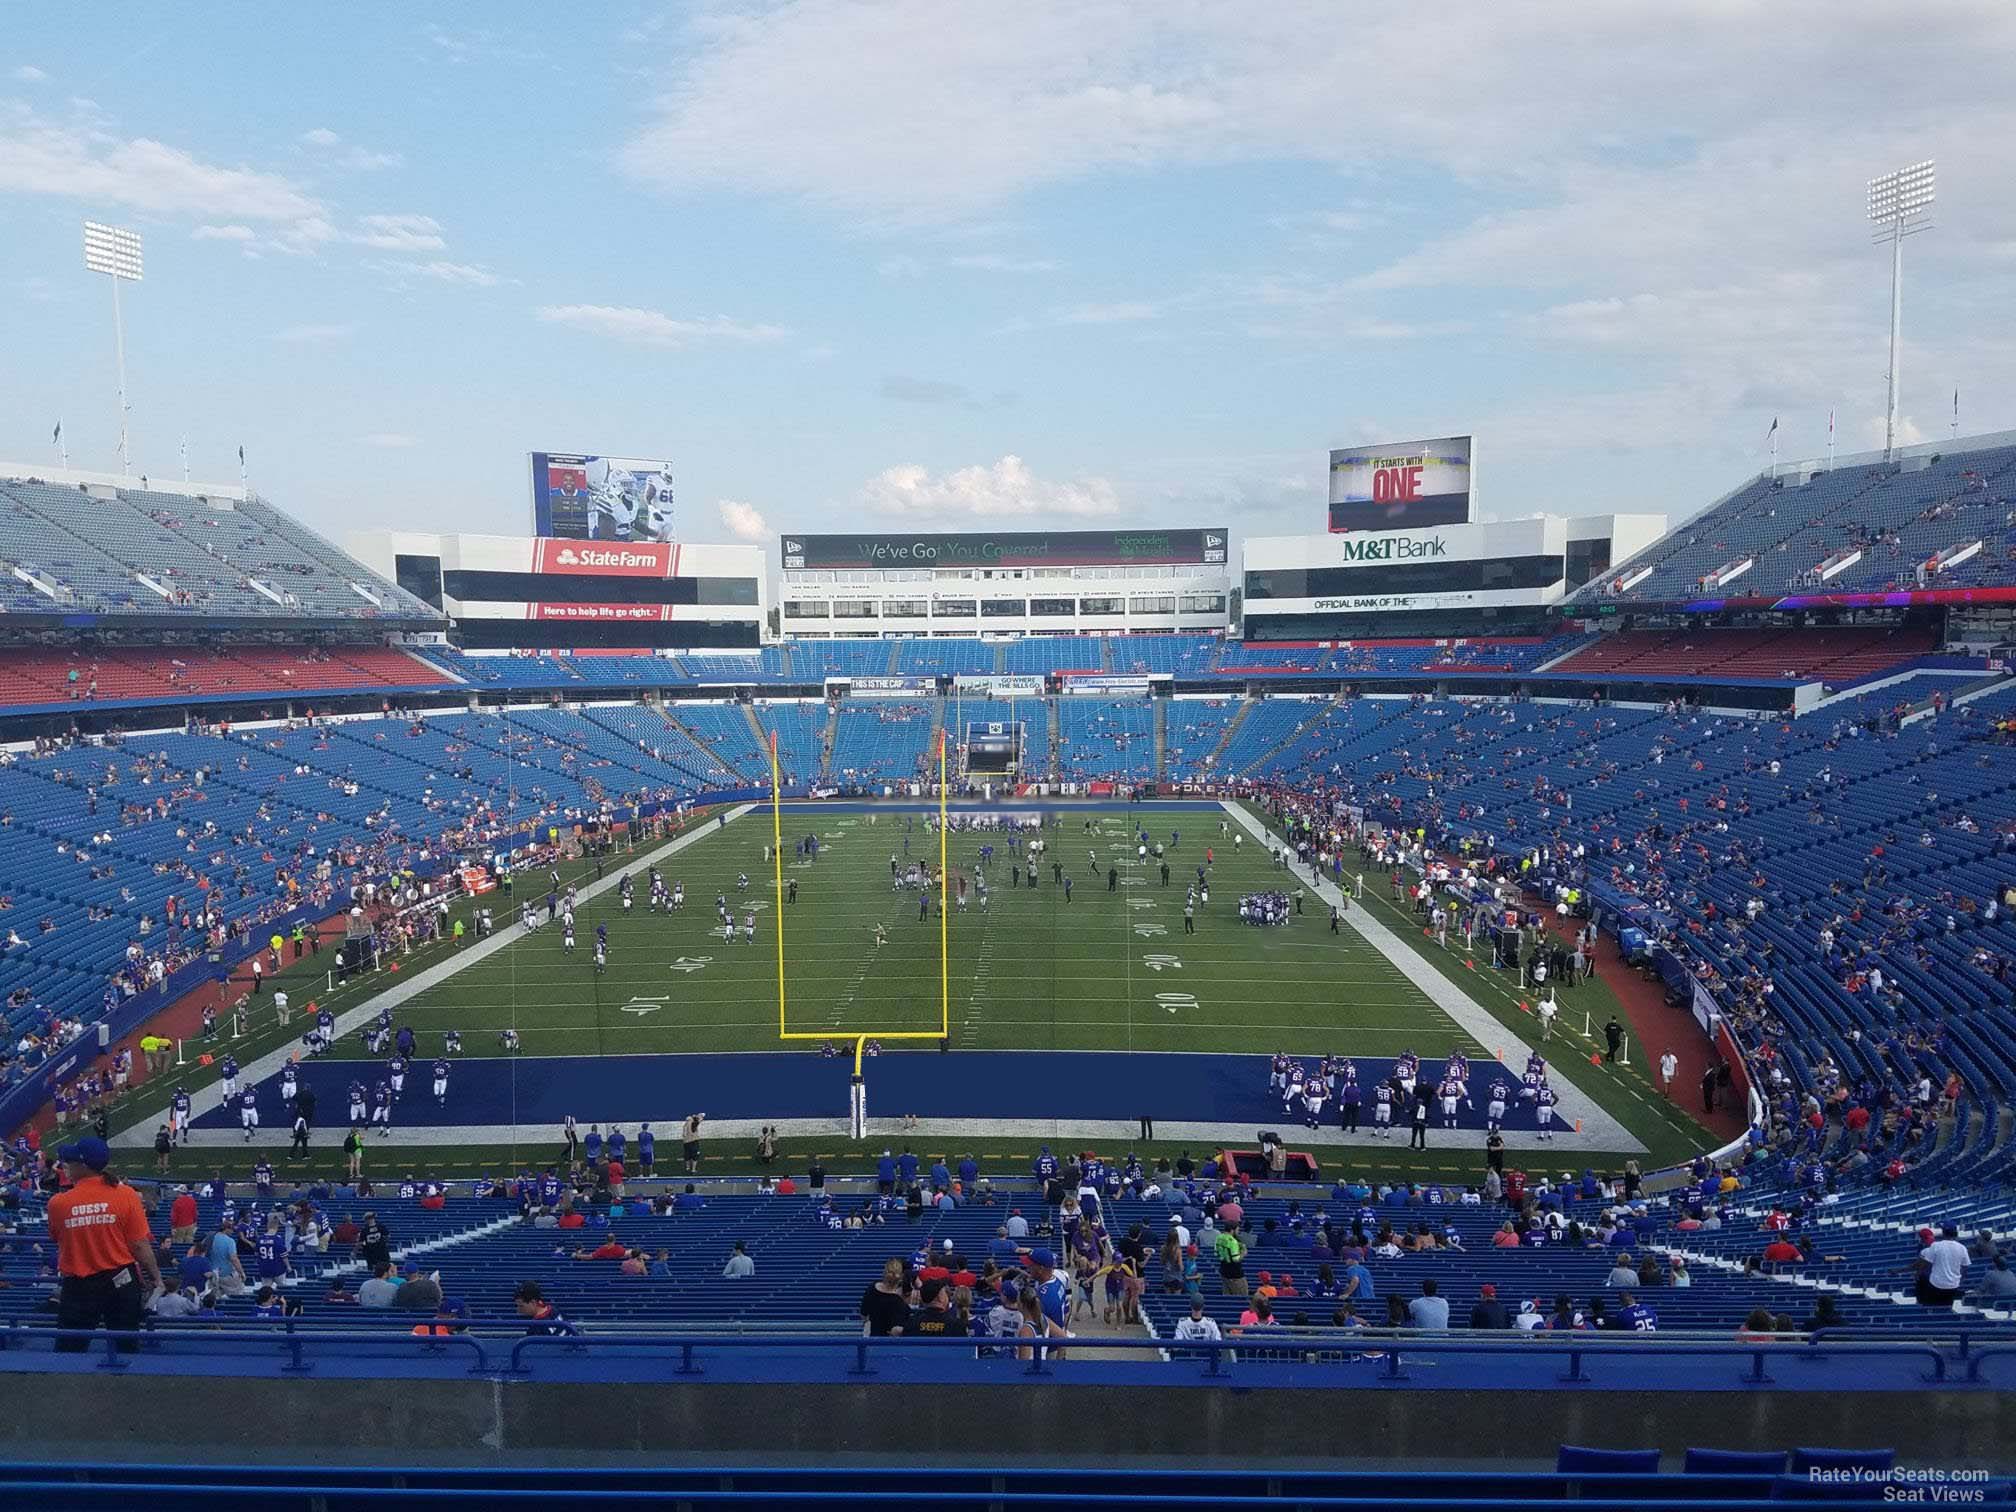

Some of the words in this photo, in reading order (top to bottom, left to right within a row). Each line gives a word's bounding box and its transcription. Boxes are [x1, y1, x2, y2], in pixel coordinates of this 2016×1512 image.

[1373, 459, 1380, 469] IT
[1381, 457, 1404, 468] STARTS
[1405, 455, 1423, 466] WITH
[1373, 466, 1424, 505] ONE
[911, 543, 940, 559] Got
[1343, 538, 1397, 562] M&T
[1397, 535, 1446, 559] Bank
[1314, 600, 1351, 609] OFFICIAL
[1354, 599, 1378, 608] BANK
[1379, 598, 1391, 607] OF
[1394, 597, 1409, 606] THE
[544, 607, 566, 617] Here
[568, 608, 577, 617] to
[578, 607, 598, 619] help
[599, 607, 614, 618] life
[615, 609, 627, 619] go
[852, 679, 867, 688] THIS
[876, 679, 889, 688] THE
[889, 679, 904, 688] CAP
[71, 1202, 109, 1216] GUEST
[64, 1213, 117, 1228] SERVICES
[259, 1246, 274, 1260] 94
